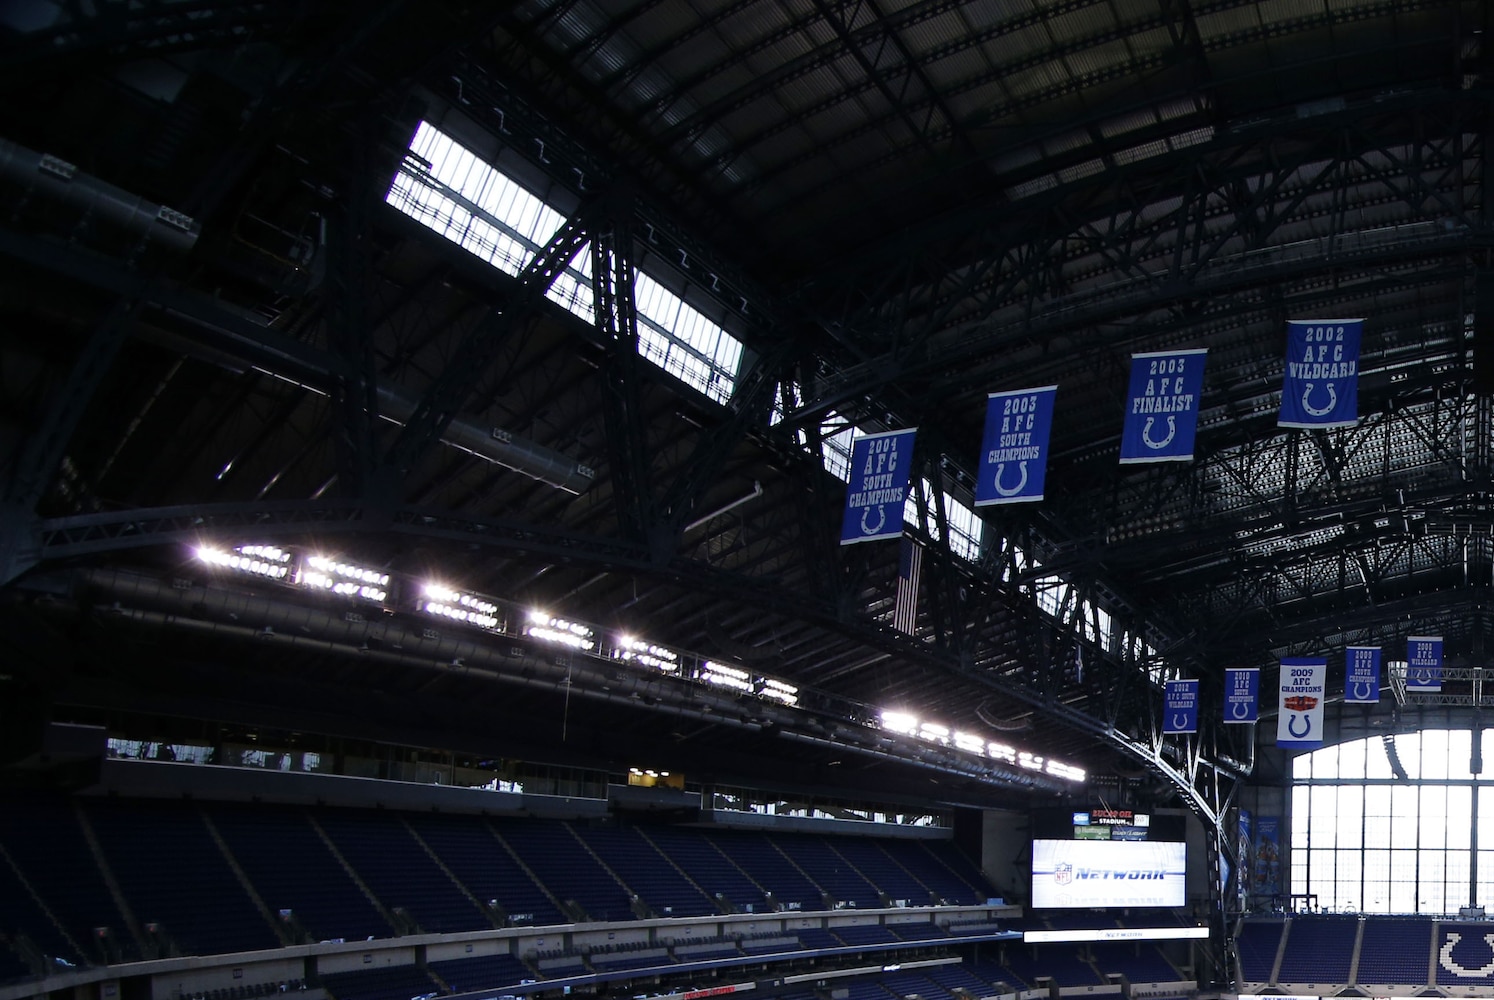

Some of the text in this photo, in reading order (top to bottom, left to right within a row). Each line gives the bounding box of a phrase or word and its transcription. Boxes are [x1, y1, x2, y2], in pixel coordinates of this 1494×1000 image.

[1306, 328, 1344, 342] 2002
[1303, 345, 1343, 362] AFC
[1150, 359, 1185, 375] 2003
[1289, 361, 1356, 379] WILDCARD
[1145, 377, 1184, 396] AFC
[1003, 396, 1037, 415] 2003
[1132, 394, 1194, 414] FINALIST
[1001, 412, 1034, 433] AFC
[869, 439, 897, 456] 2004
[1000, 432, 1032, 448] SOUTH
[864, 451, 897, 475] AFC
[988, 446, 1040, 464] CHAMPIONS
[863, 474, 893, 491] SOUTH
[849, 487, 903, 508] CHAMPIONS
[1290, 669, 1313, 677] 2009
[1293, 678, 1310, 686] AFC
[1056, 867, 1167, 882] NFL NETWORK
